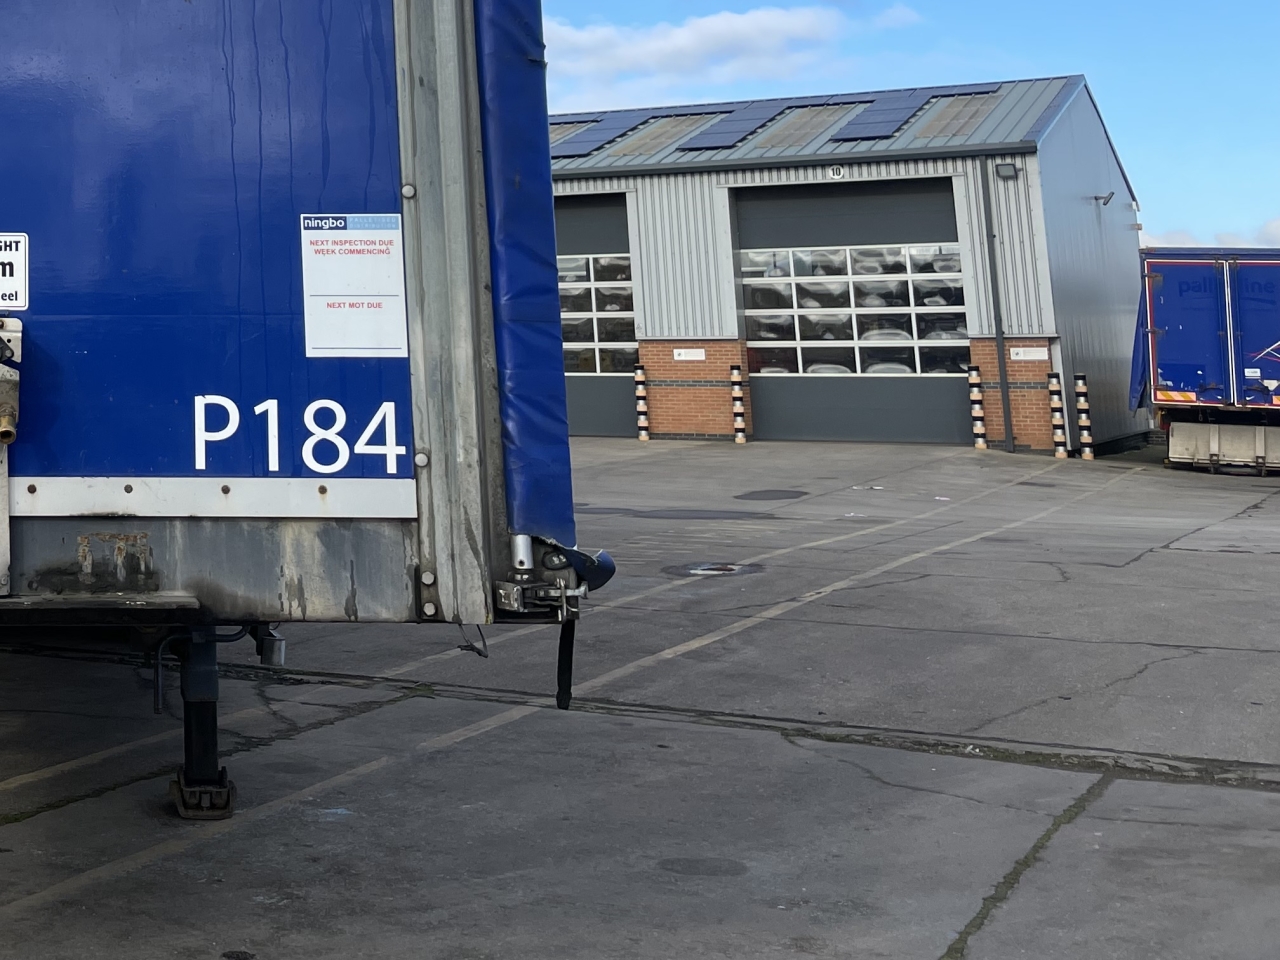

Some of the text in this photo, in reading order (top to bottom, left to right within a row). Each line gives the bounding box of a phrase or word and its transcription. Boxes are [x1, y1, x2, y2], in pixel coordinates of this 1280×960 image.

[831, 167, 841, 177] 10
[304, 217, 345, 230] ningbo
[194, 394, 407, 474] P184
